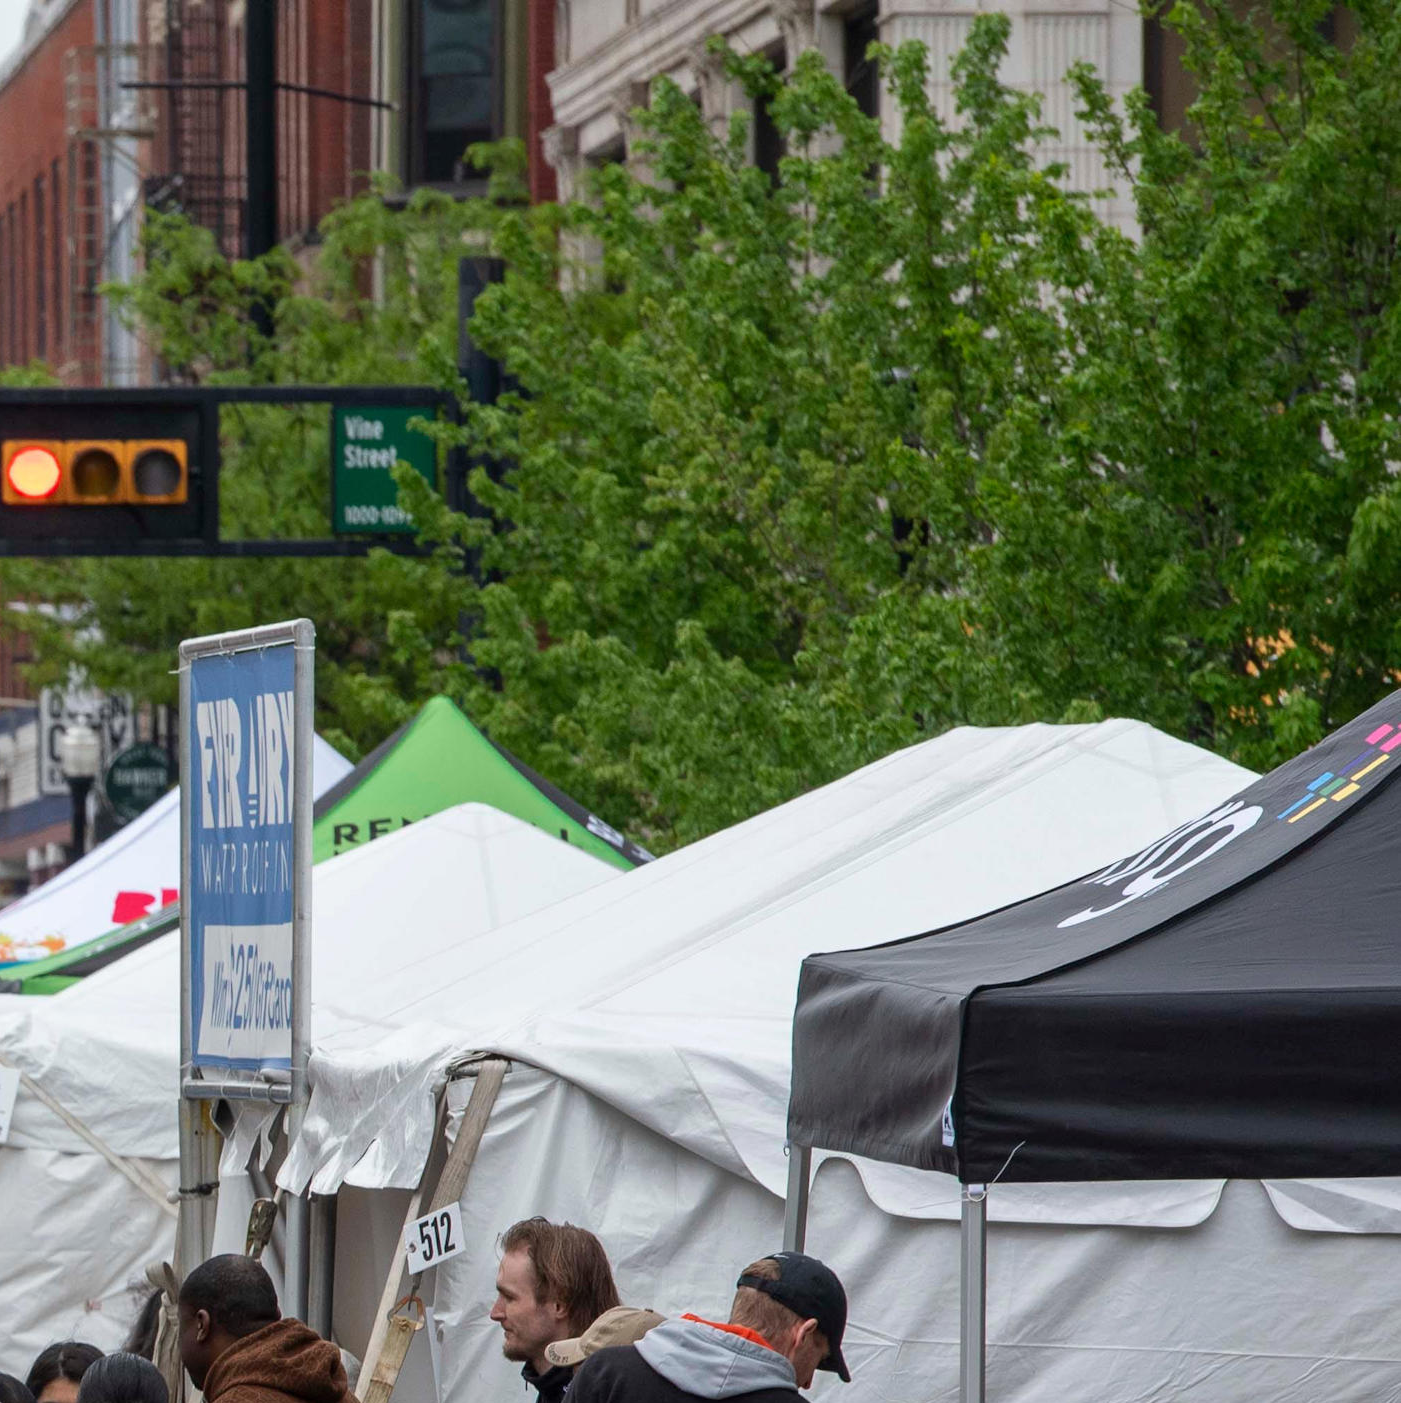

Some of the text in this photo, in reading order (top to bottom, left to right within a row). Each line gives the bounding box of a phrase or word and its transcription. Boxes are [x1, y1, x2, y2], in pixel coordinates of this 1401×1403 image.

[344, 415, 384, 440] Vine
[343, 444, 397, 469] Street
[418, 1211, 457, 1262] 512
